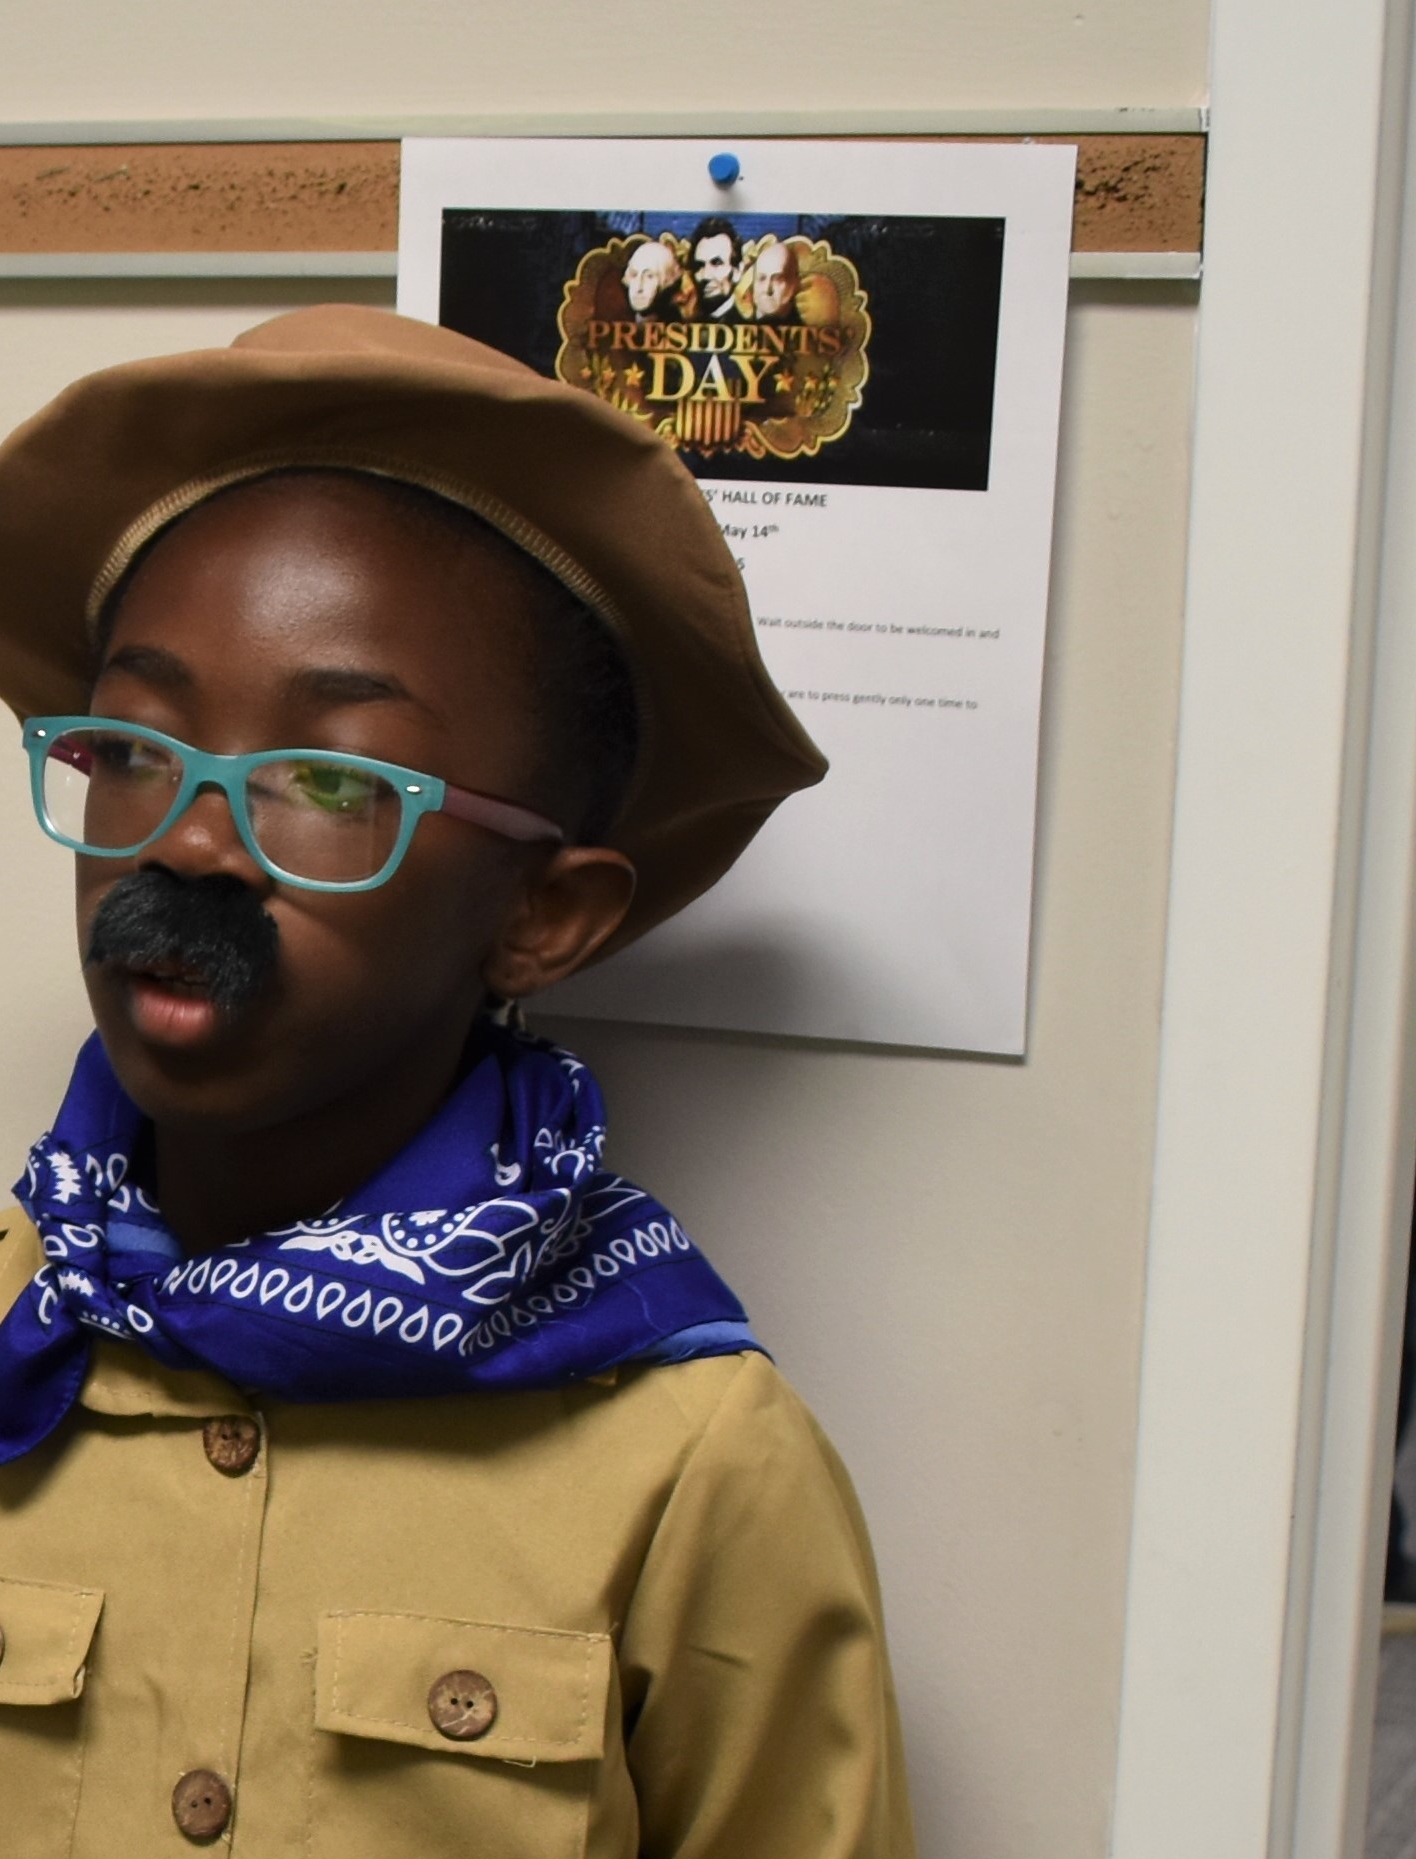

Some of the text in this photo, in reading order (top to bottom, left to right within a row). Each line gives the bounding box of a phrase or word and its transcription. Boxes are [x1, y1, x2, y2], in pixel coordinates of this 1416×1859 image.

[645, 352, 780, 403] DAY
[722, 489, 757, 504] HALL
[762, 491, 781, 505] OF
[785, 493, 828, 507] FAME
[784, 618, 824, 630] outside
[827, 620, 845, 631] the
[847, 621, 873, 633] door
[876, 623, 888, 633] to
[890, 624, 903, 634] be
[907, 625, 963, 637] welcomed
[965, 627, 976, 637] in
[979, 628, 1000, 639] and
[808, 690, 819, 700] to
[966, 699, 978, 709] to
